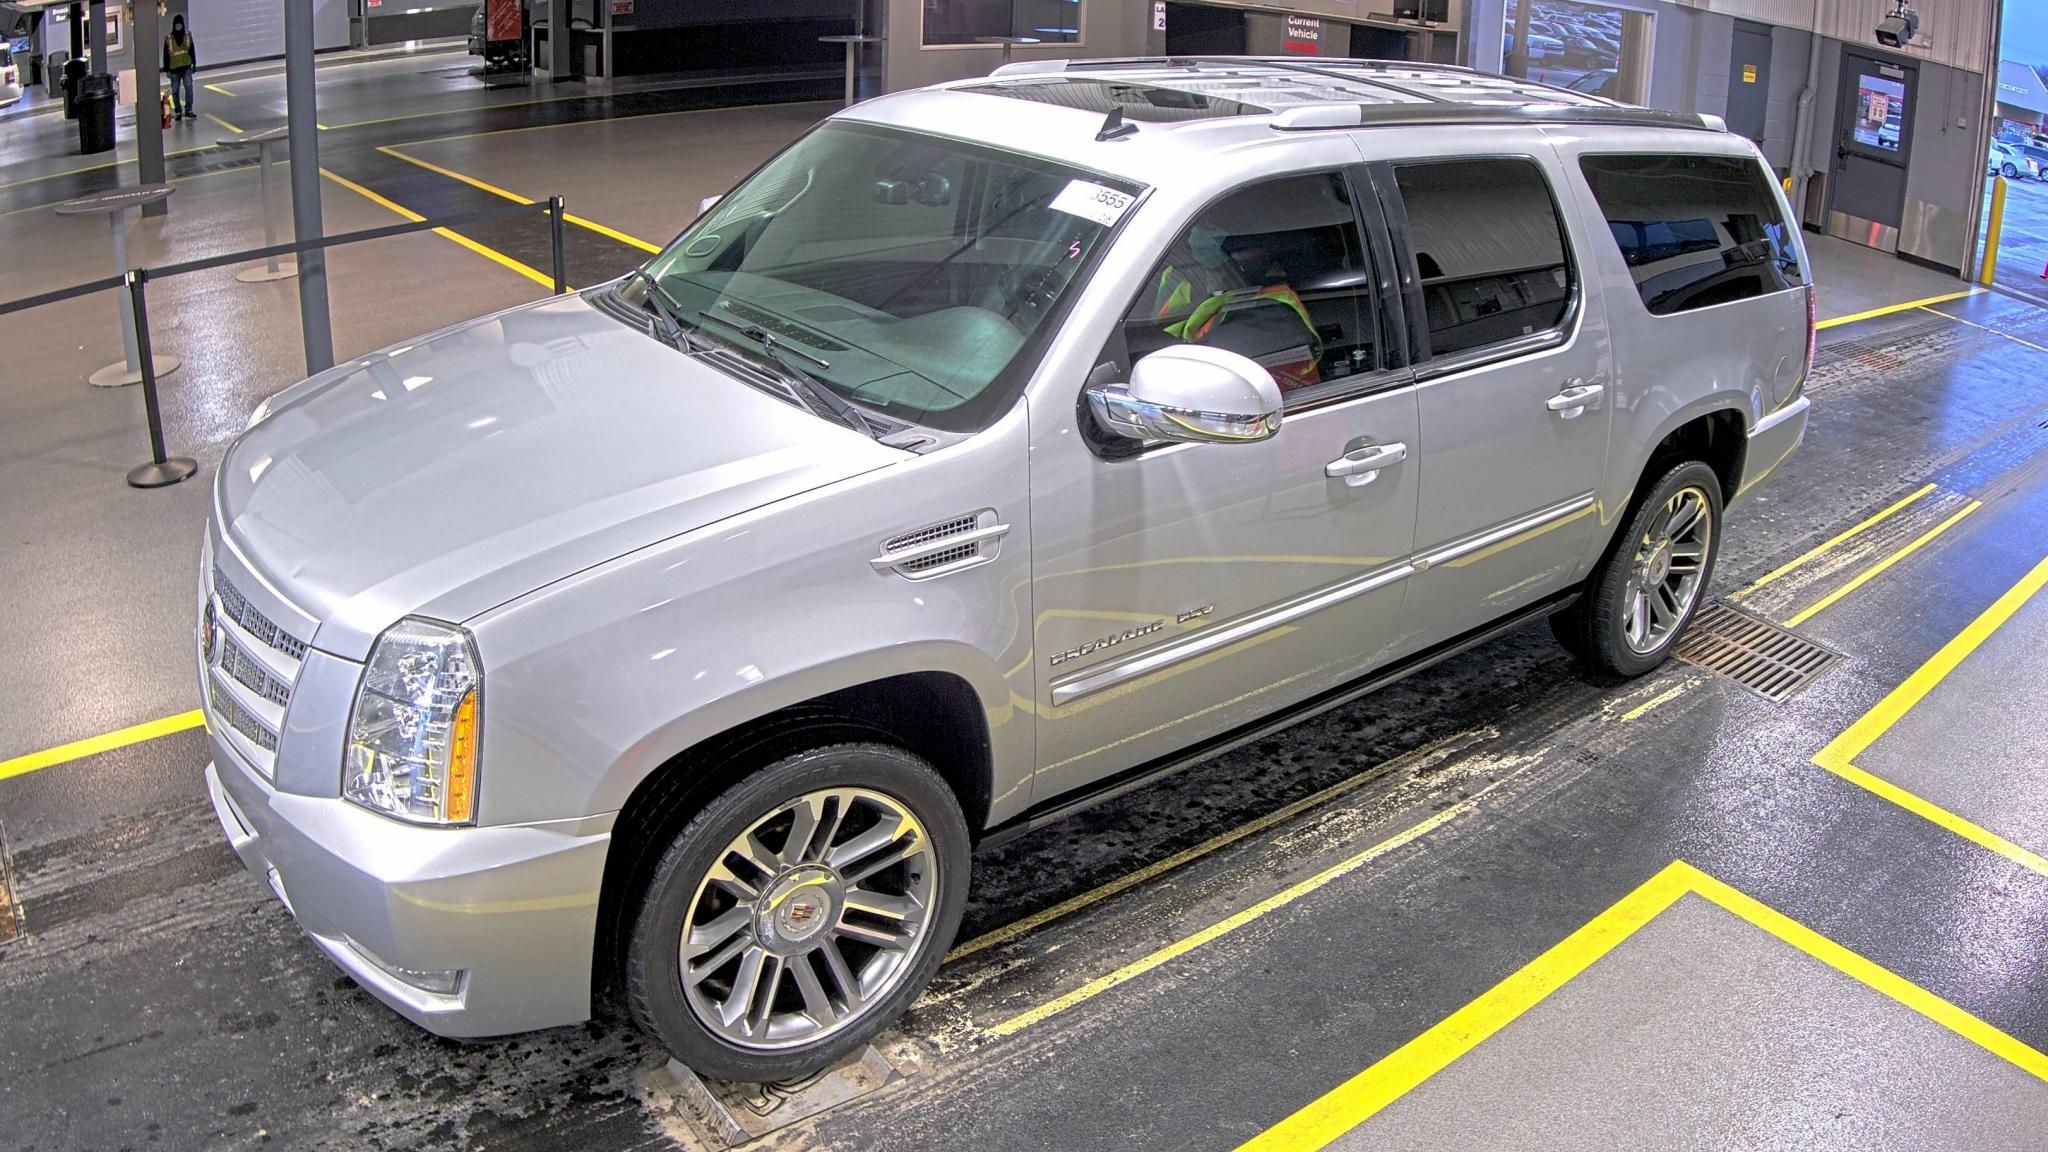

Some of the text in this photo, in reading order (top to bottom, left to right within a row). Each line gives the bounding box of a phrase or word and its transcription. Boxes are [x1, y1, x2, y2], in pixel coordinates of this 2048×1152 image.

[1158, 18, 1165, 28] 2
[1288, 14, 1320, 28] Current
[1288, 27, 1319, 40] Vehicle
